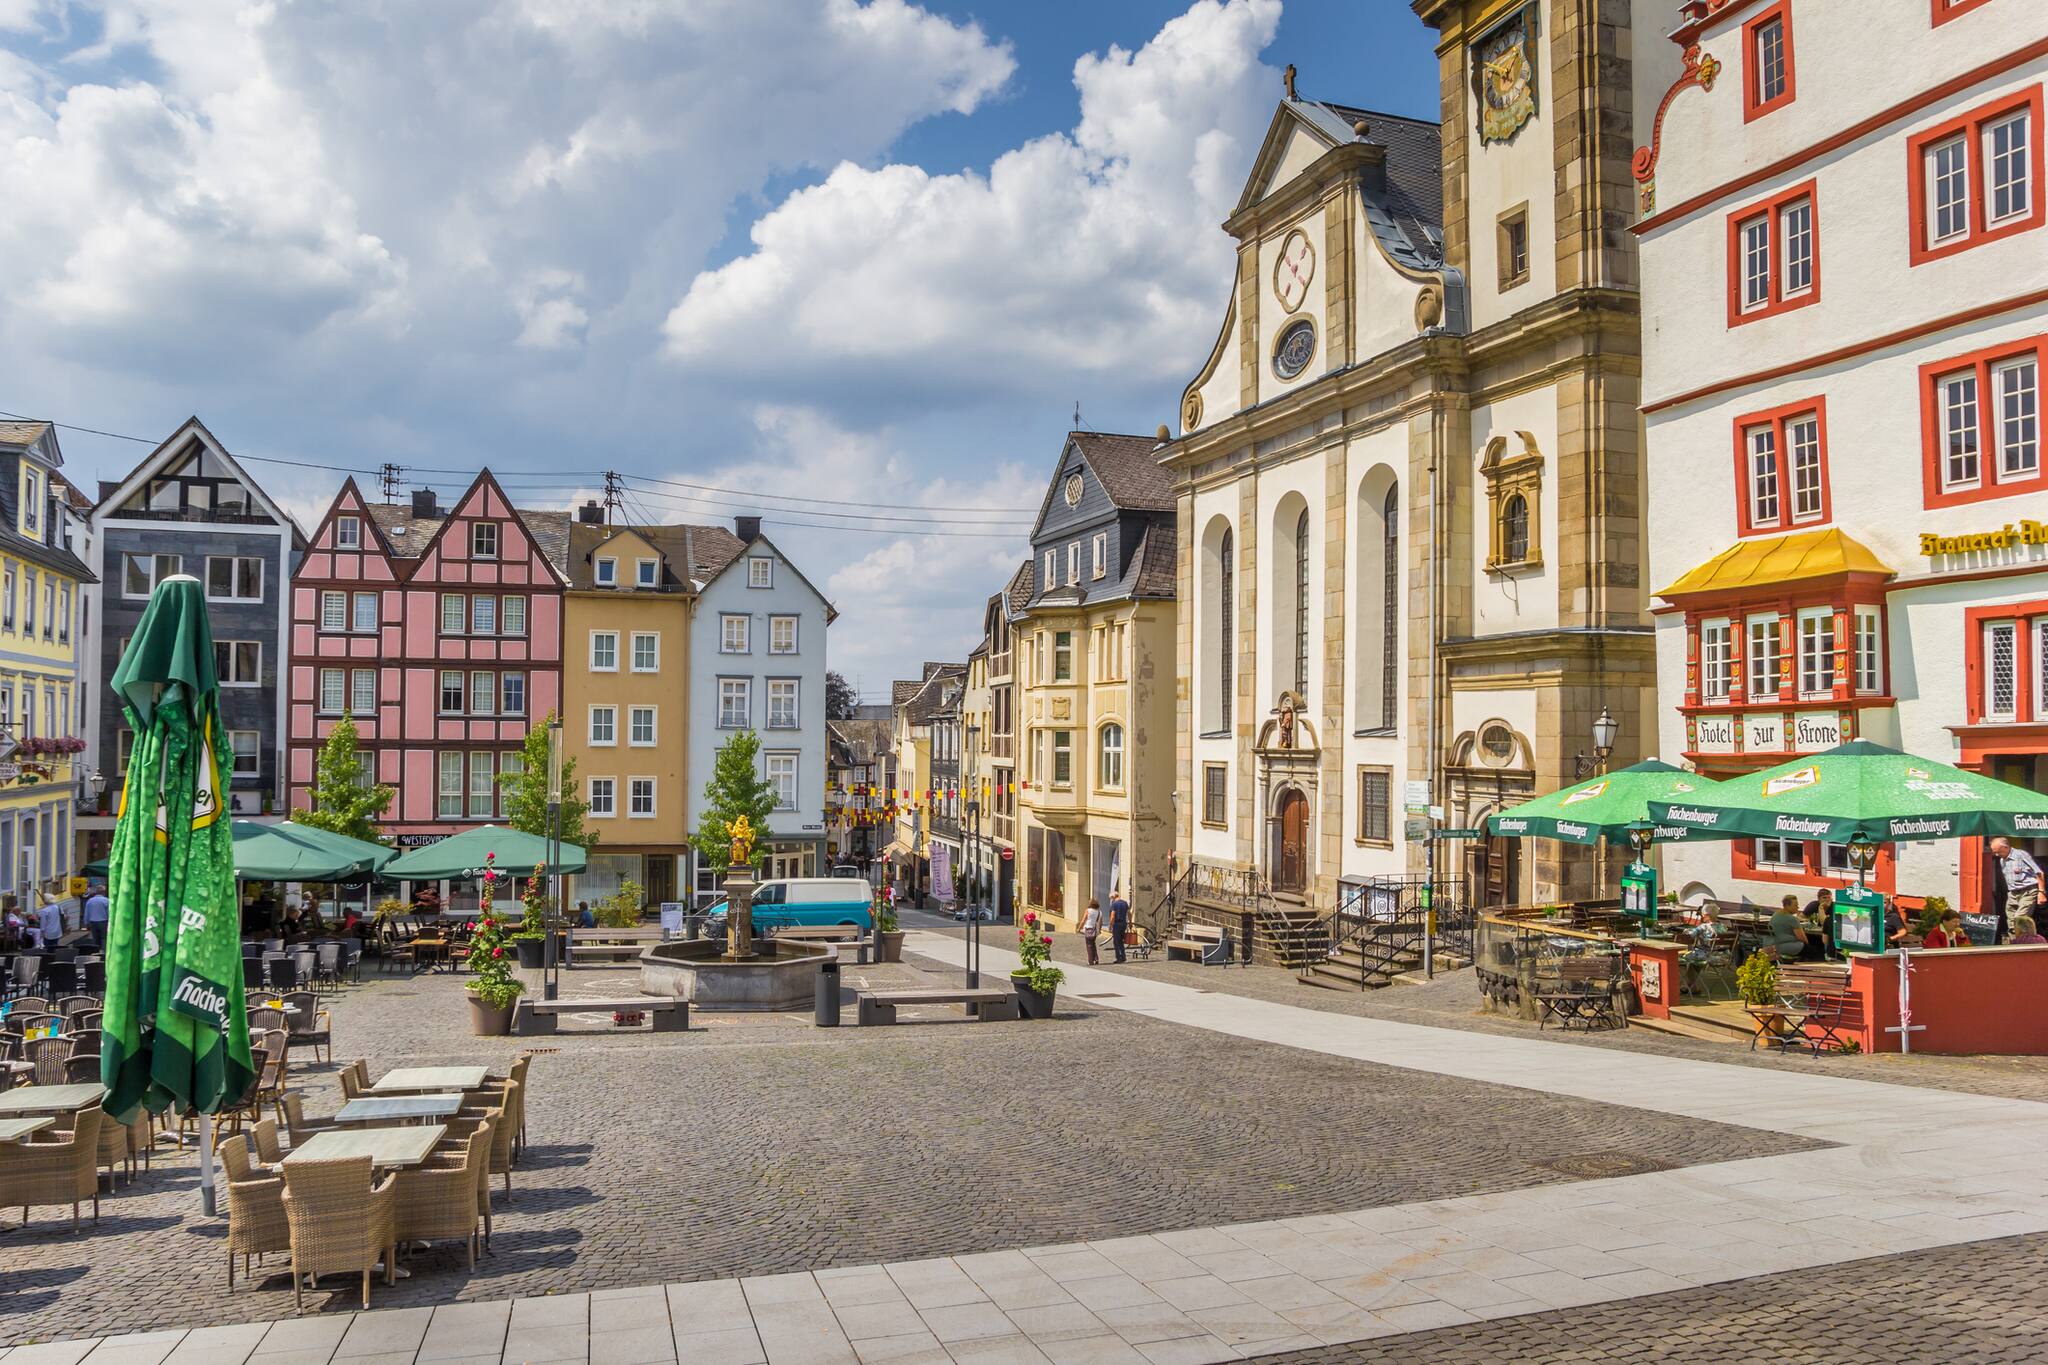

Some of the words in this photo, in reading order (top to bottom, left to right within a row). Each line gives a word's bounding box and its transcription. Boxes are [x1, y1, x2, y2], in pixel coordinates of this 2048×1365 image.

[1700, 721, 1732, 743] Hotel
[1754, 726, 1775, 746] zur
[1798, 719, 1838, 744] Krone
[1667, 805, 1719, 826] Hachenburger
[1776, 815, 1831, 836] Hachenburger
[1890, 818, 1950, 836] Hachenburger
